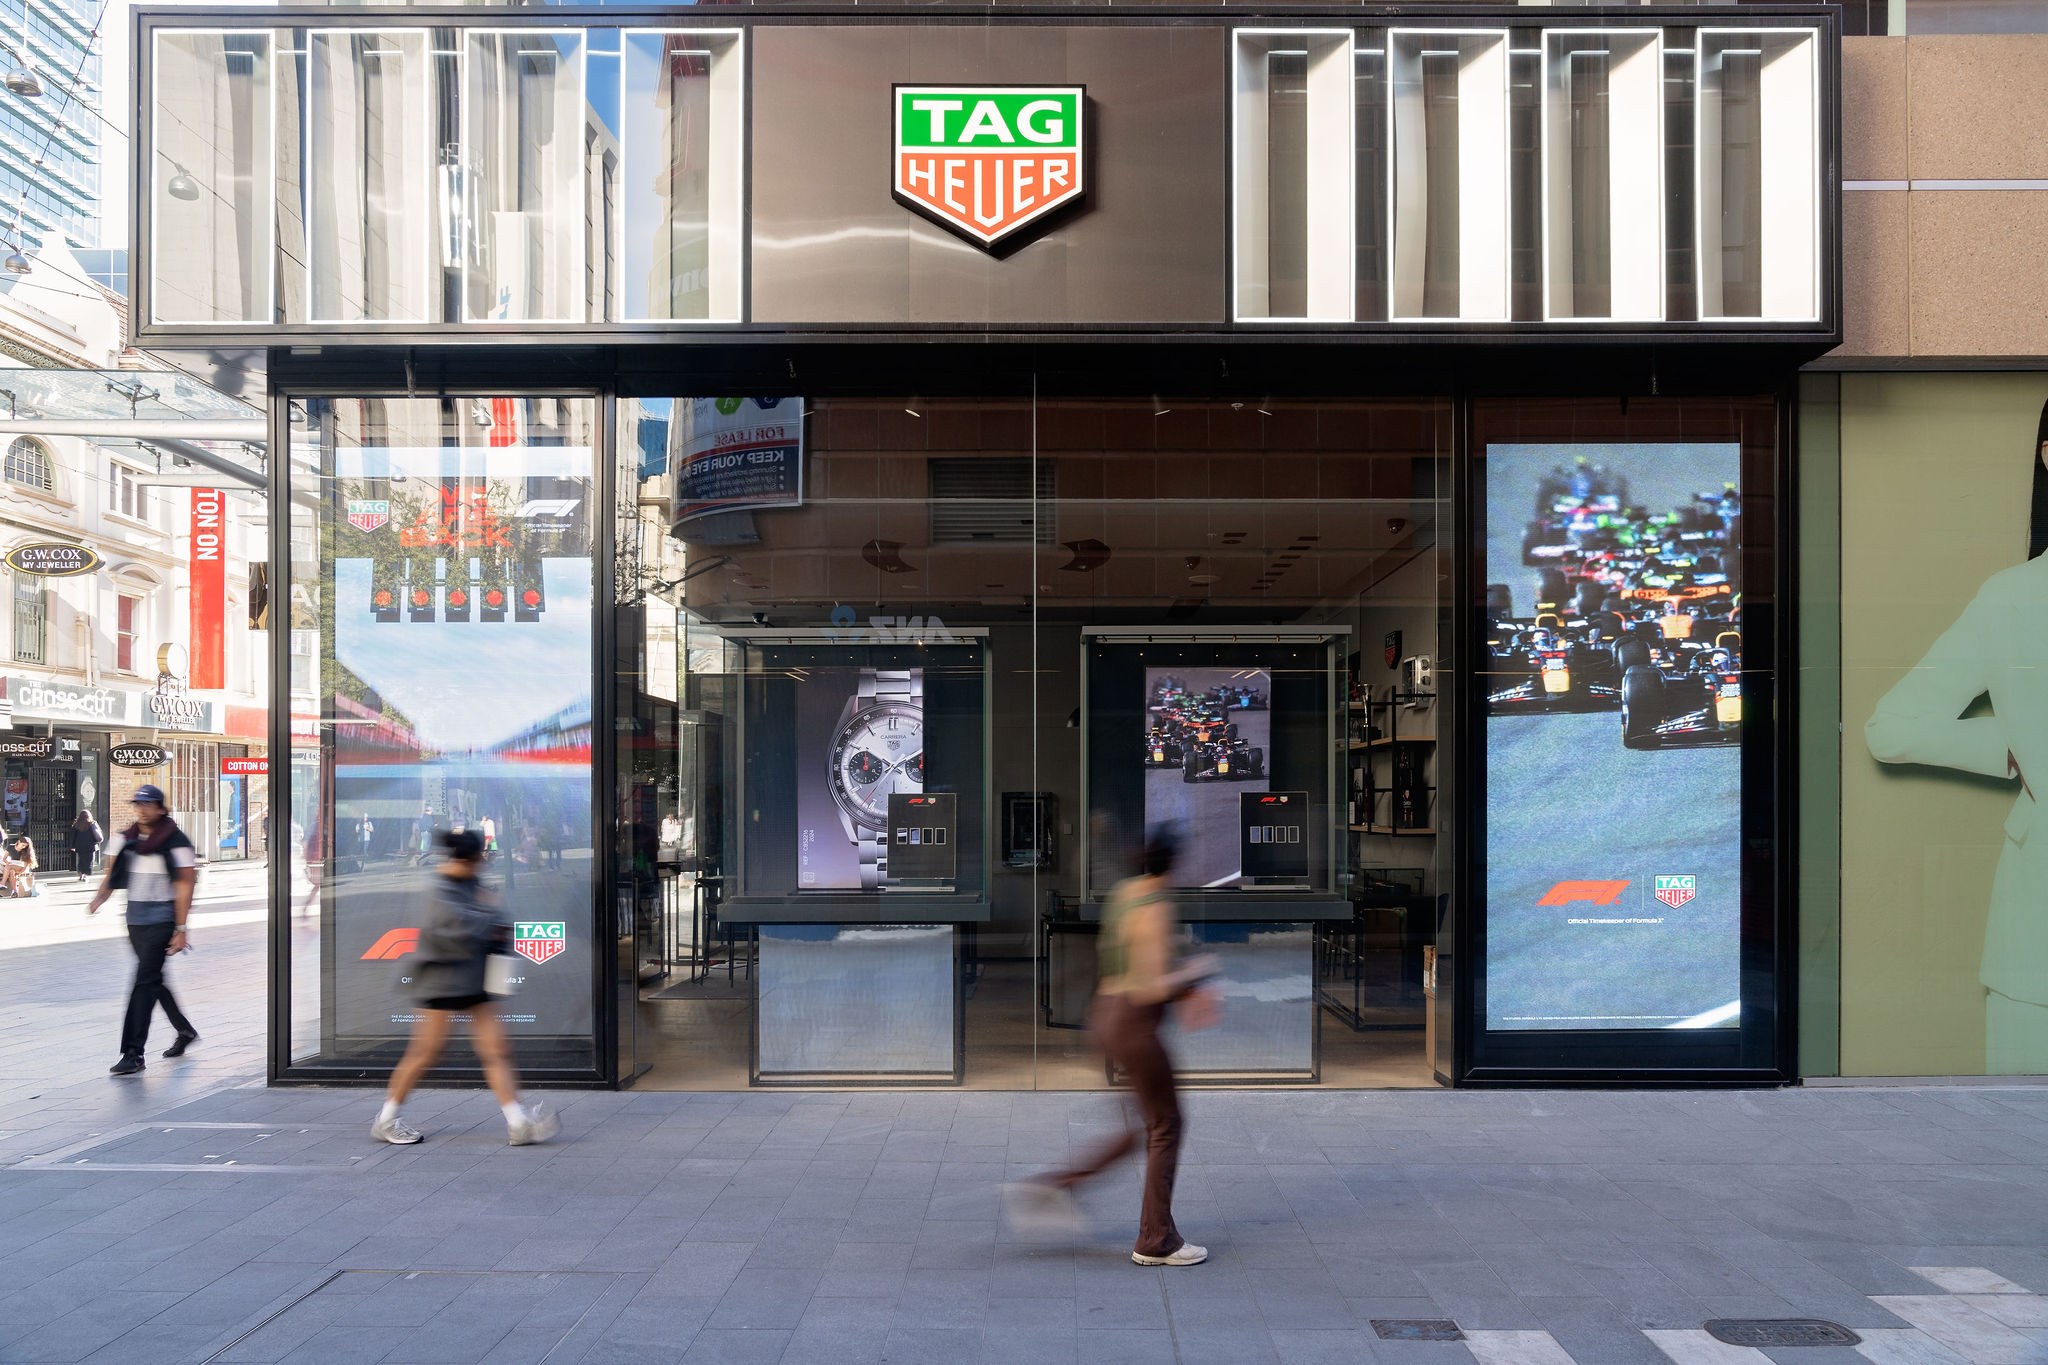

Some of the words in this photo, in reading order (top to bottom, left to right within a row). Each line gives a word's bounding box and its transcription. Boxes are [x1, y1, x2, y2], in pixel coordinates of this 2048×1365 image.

[912, 99, 1064, 144] TAG
[908, 158, 1069, 228] HEUER
[197, 489, 218, 528] TON
[353, 502, 385, 512] TAG
[350, 514, 387, 530] HEUER
[196, 534, 218, 560] ON
[51, 549, 81, 560] COX
[36, 561, 81, 569] JEWELLER
[0, 743, 25, 753] OSS
[30, 743, 52, 753] CUT
[135, 750, 160, 759] COX
[228, 761, 258, 771] COTTON
[1658, 877, 1692, 888] TAG
[1657, 890, 1694, 906] HEUER
[518, 924, 561, 938] TAG
[517, 941, 563, 961] HEUER
